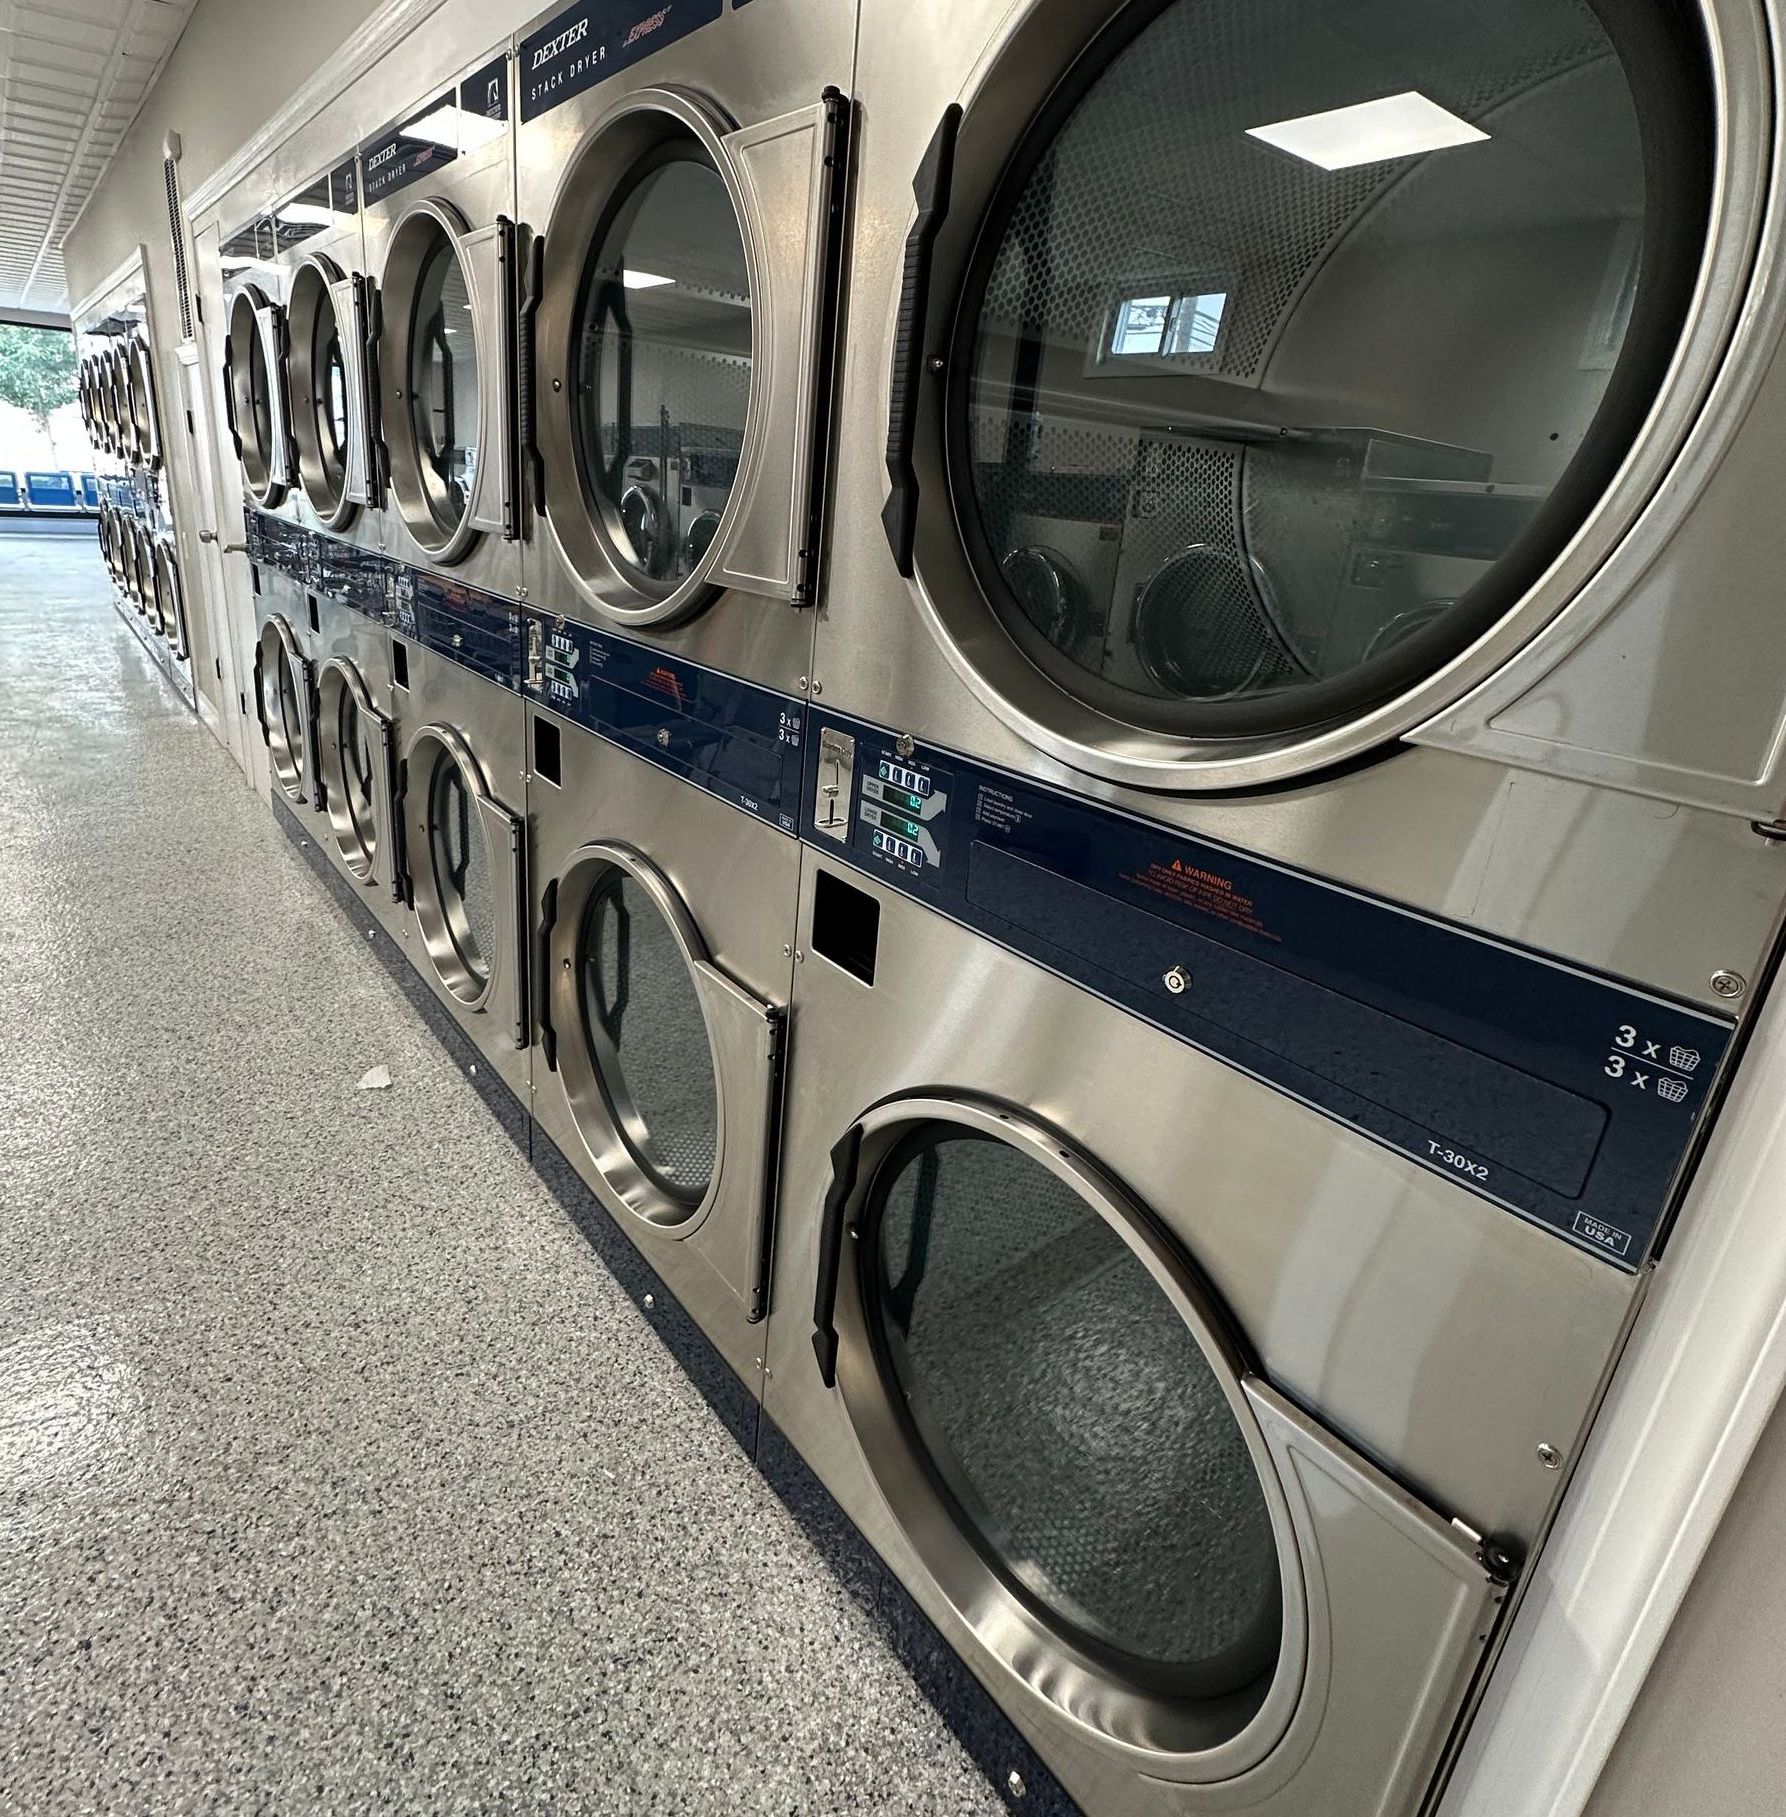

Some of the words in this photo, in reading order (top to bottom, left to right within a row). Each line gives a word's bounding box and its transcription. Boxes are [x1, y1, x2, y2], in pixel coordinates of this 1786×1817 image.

[531, 17, 589, 71] DEXTER
[531, 70, 563, 101] STACK
[569, 45, 606, 78] DRYER
[368, 142, 397, 171] DEXTER
[368, 175, 386, 193] STACK
[387, 162, 407, 182] DRYER
[779, 711, 786, 724] 3
[778, 728, 785, 741] 3
[1184, 865, 1233, 891] WARNING
[1614, 1024, 1637, 1048] 3
[1641, 1040, 1662, 1060] x
[1604, 1055, 1626, 1078] 3
[1630, 1071, 1650, 1090] x
[1427, 1139, 1490, 1182] T-30X2
[1584, 1217, 1611, 1235] MADE
[1611, 1231, 1622, 1240] IN
[1584, 1225, 1615, 1247] USA
